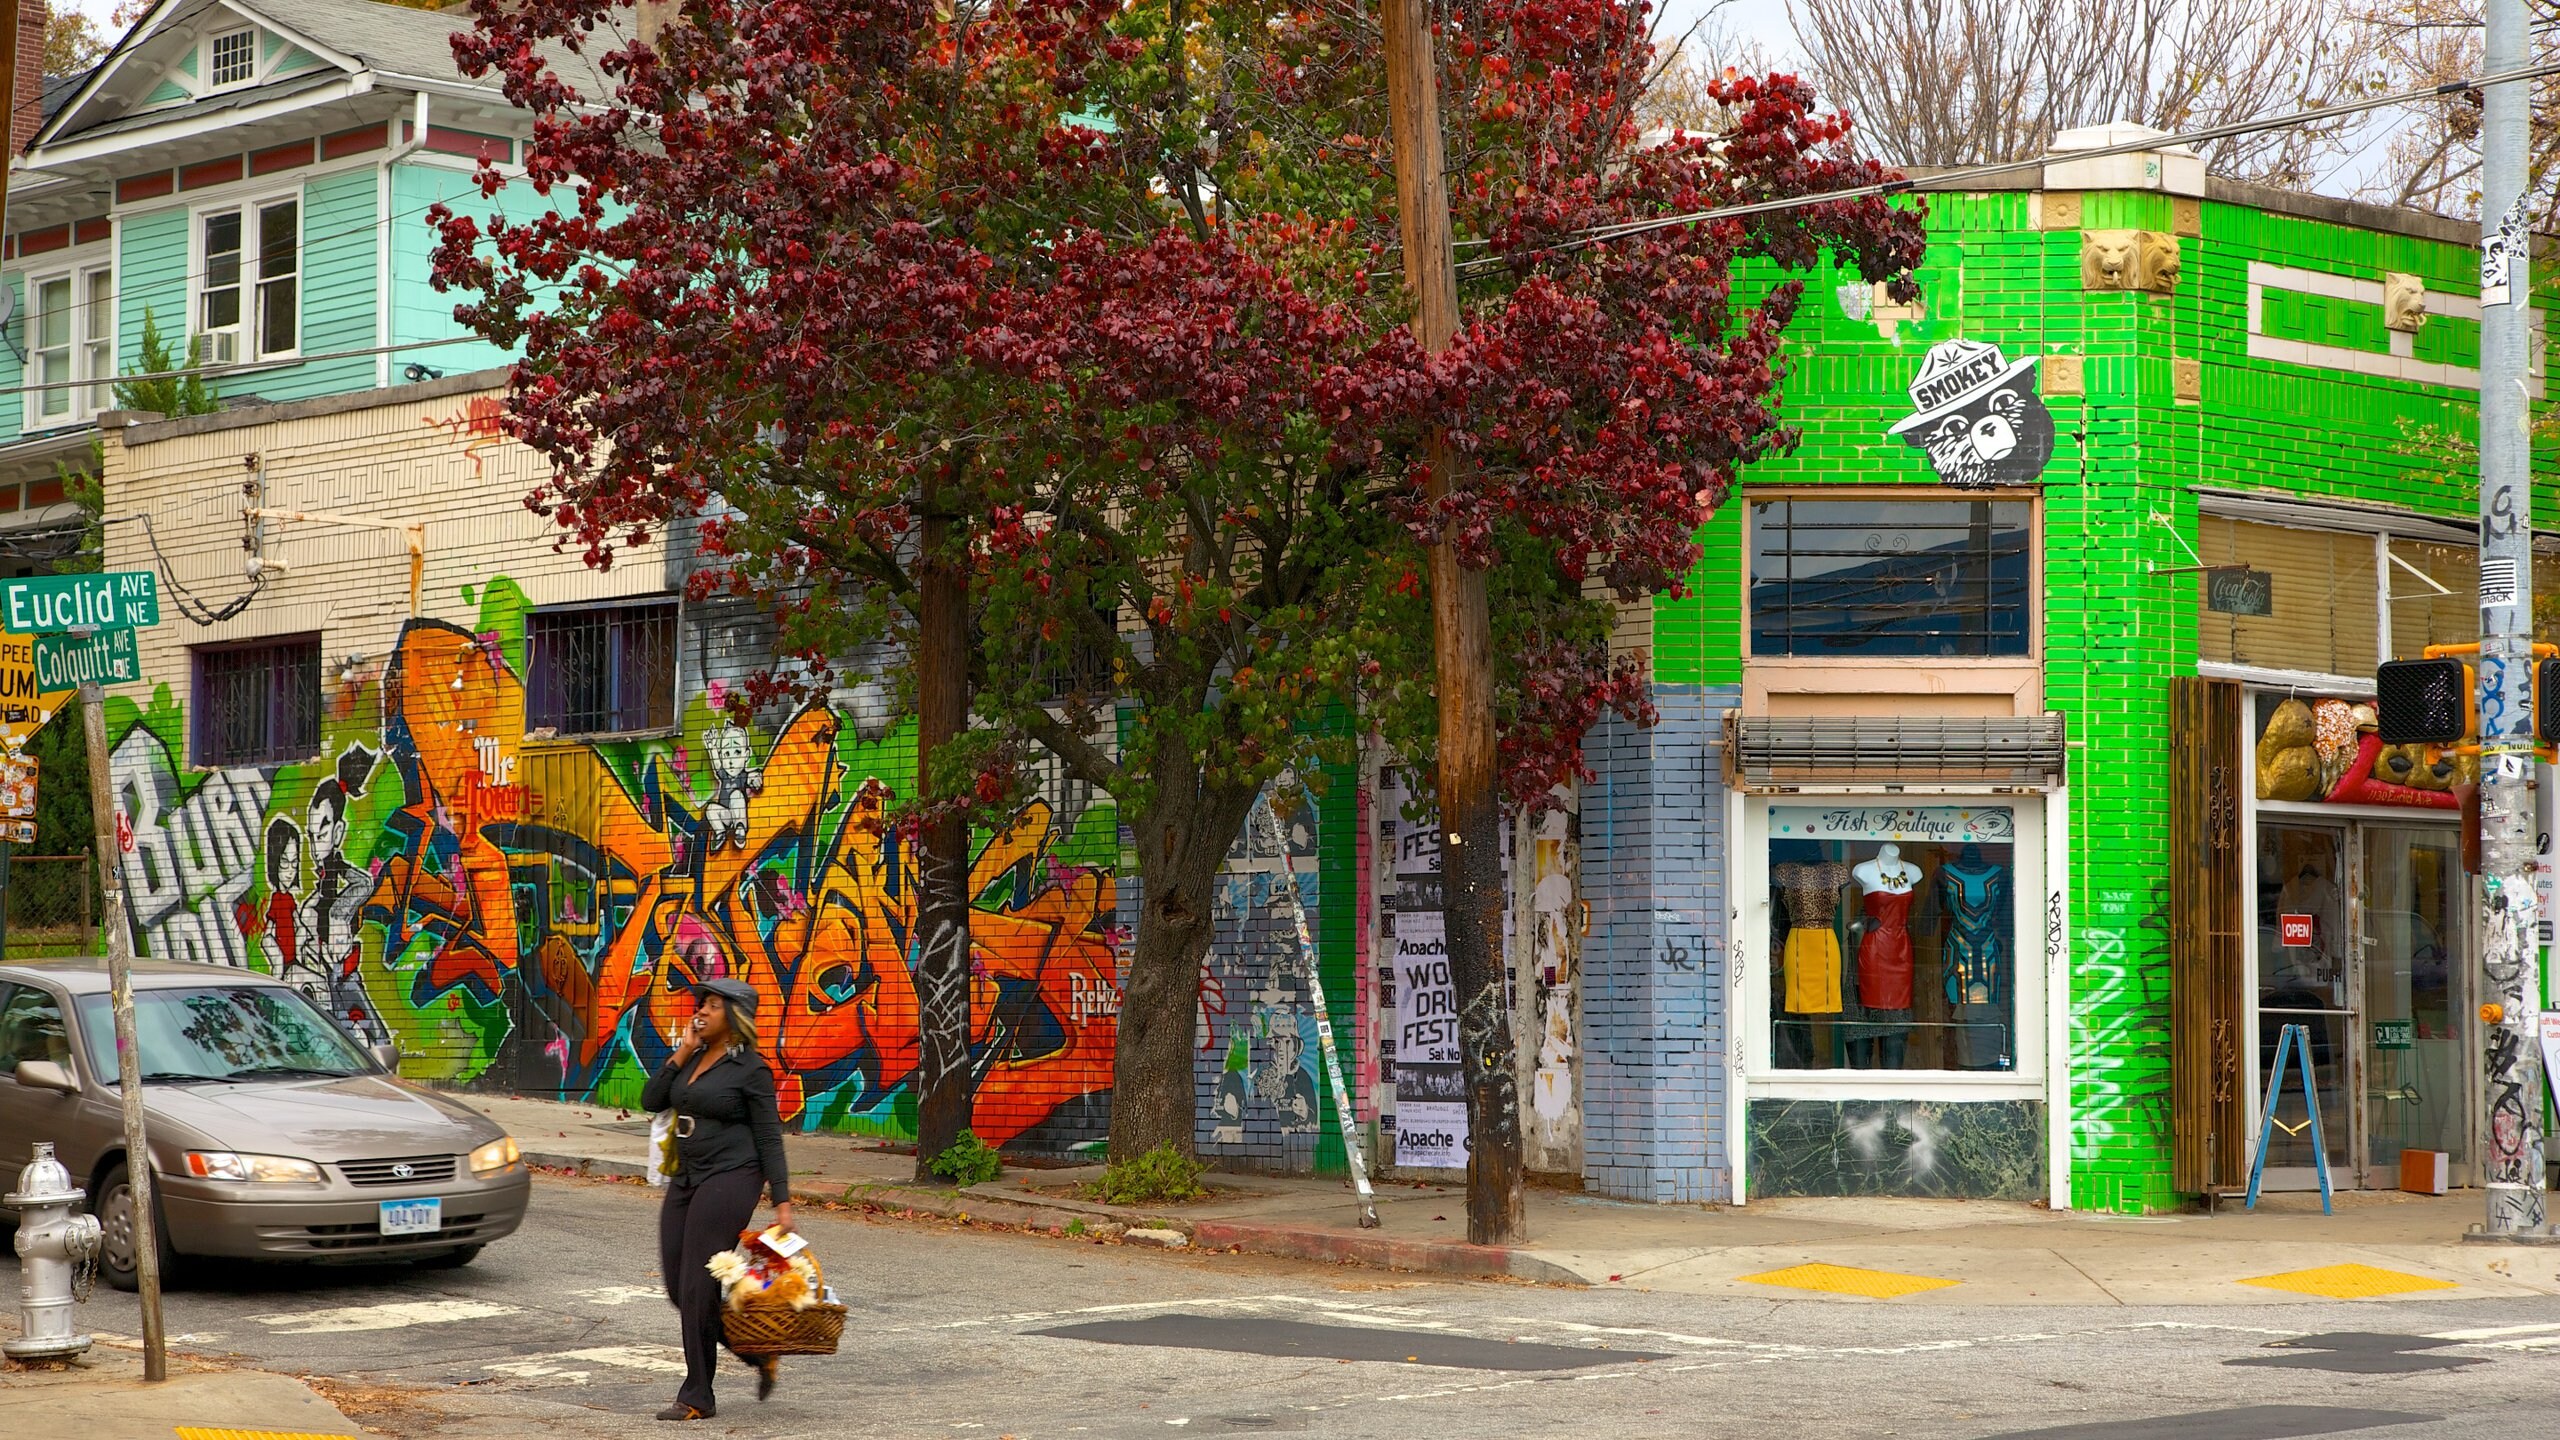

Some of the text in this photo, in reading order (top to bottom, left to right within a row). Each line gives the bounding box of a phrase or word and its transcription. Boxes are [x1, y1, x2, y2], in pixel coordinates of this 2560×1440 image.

[1916, 351, 2001, 410] SMOKEY
[8, 574, 151, 628] Euclid AVE
[126, 602, 149, 624] NE
[2, 644, 33, 664] PEE
[37, 629, 132, 689] Colquitt AVE
[0, 668, 40, 700] UM
[1826, 810, 1956, 840] Fish Boutique
[1403, 829, 1441, 861] FES
[1429, 858, 1441, 871] Sa
[2285, 923, 2310, 938] OPEN
[1398, 938, 1448, 955] Apach
[1660, 938, 1695, 971] JR
[1406, 962, 1449, 990] WO
[2317, 968, 2342, 983] PUSH
[1416, 990, 1458, 1018] DRU
[1404, 1018, 1457, 1049] FEST
[1429, 1048, 1460, 1061] Sat No
[1400, 1128, 1454, 1150] Apache
